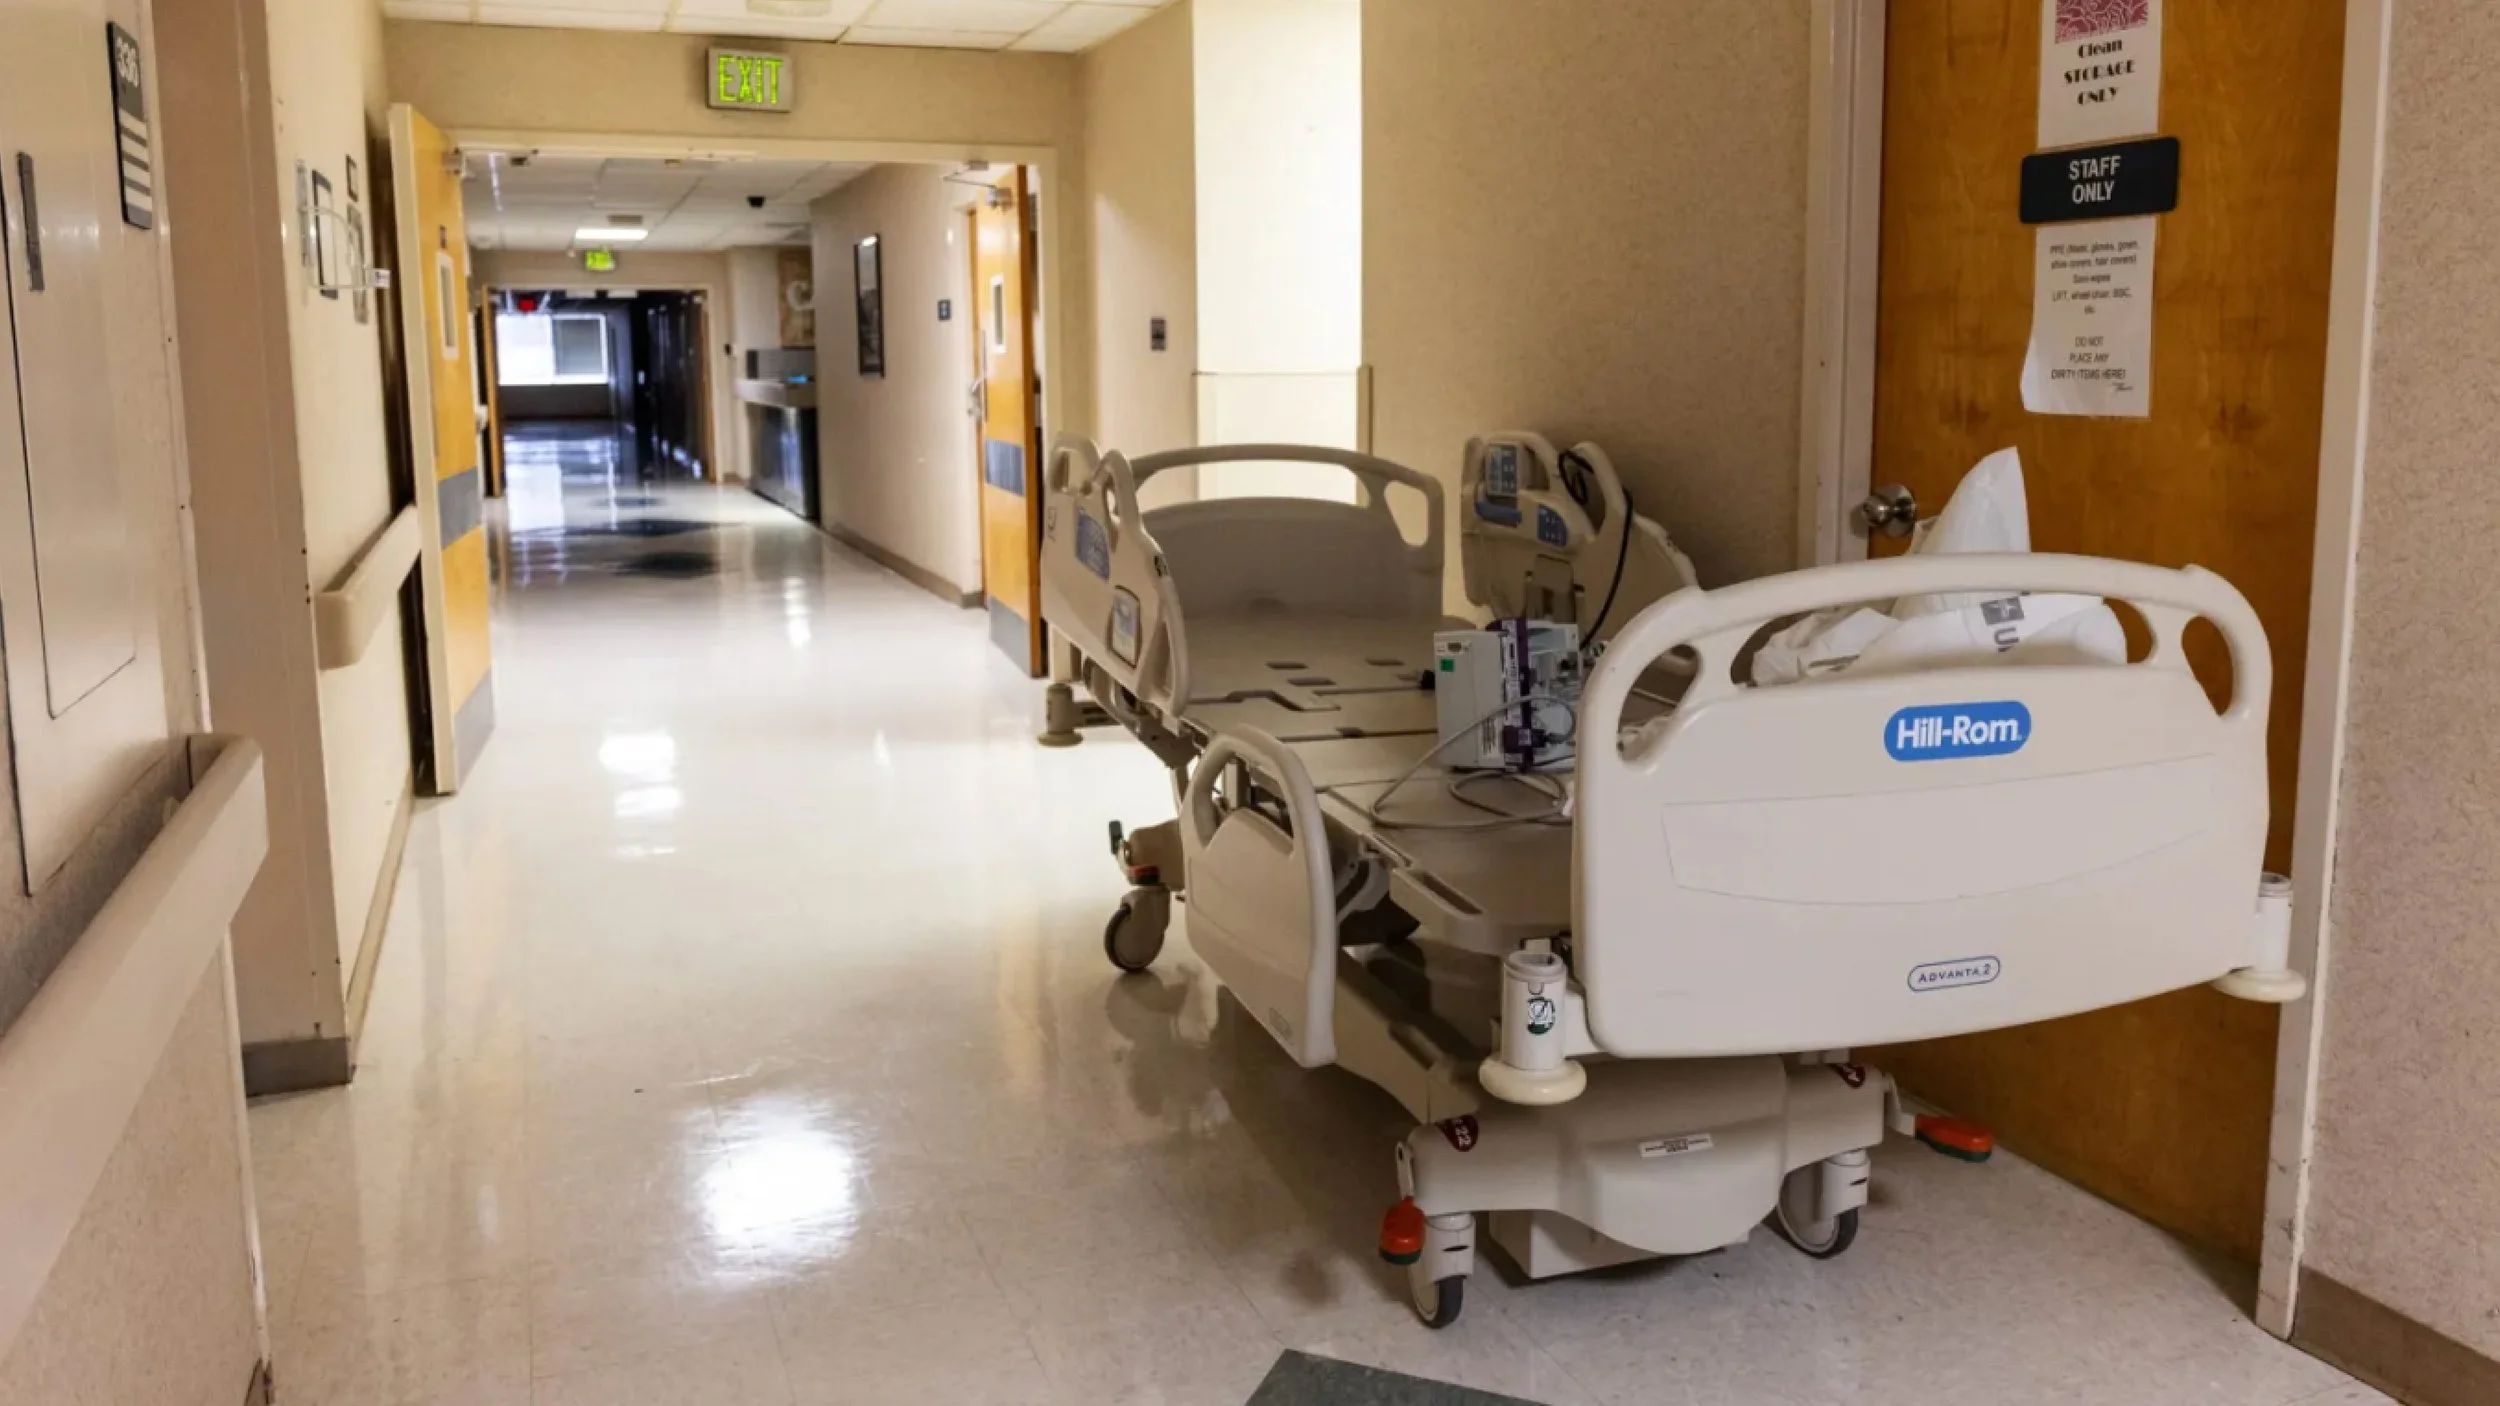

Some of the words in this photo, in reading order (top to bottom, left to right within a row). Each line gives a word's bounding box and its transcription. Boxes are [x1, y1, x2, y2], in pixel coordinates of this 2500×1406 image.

[2078, 40, 2122, 58] Clean
[718, 55, 783, 104] EXIT
[2064, 60, 2135, 84] STORAGE
[2077, 86, 2119, 105] ONLY
[2069, 155, 2122, 181] STAFF
[2072, 180, 2115, 204] ONLY
[2069, 352, 2093, 364] PLACE
[1896, 715, 2020, 750] Hill-Rom
